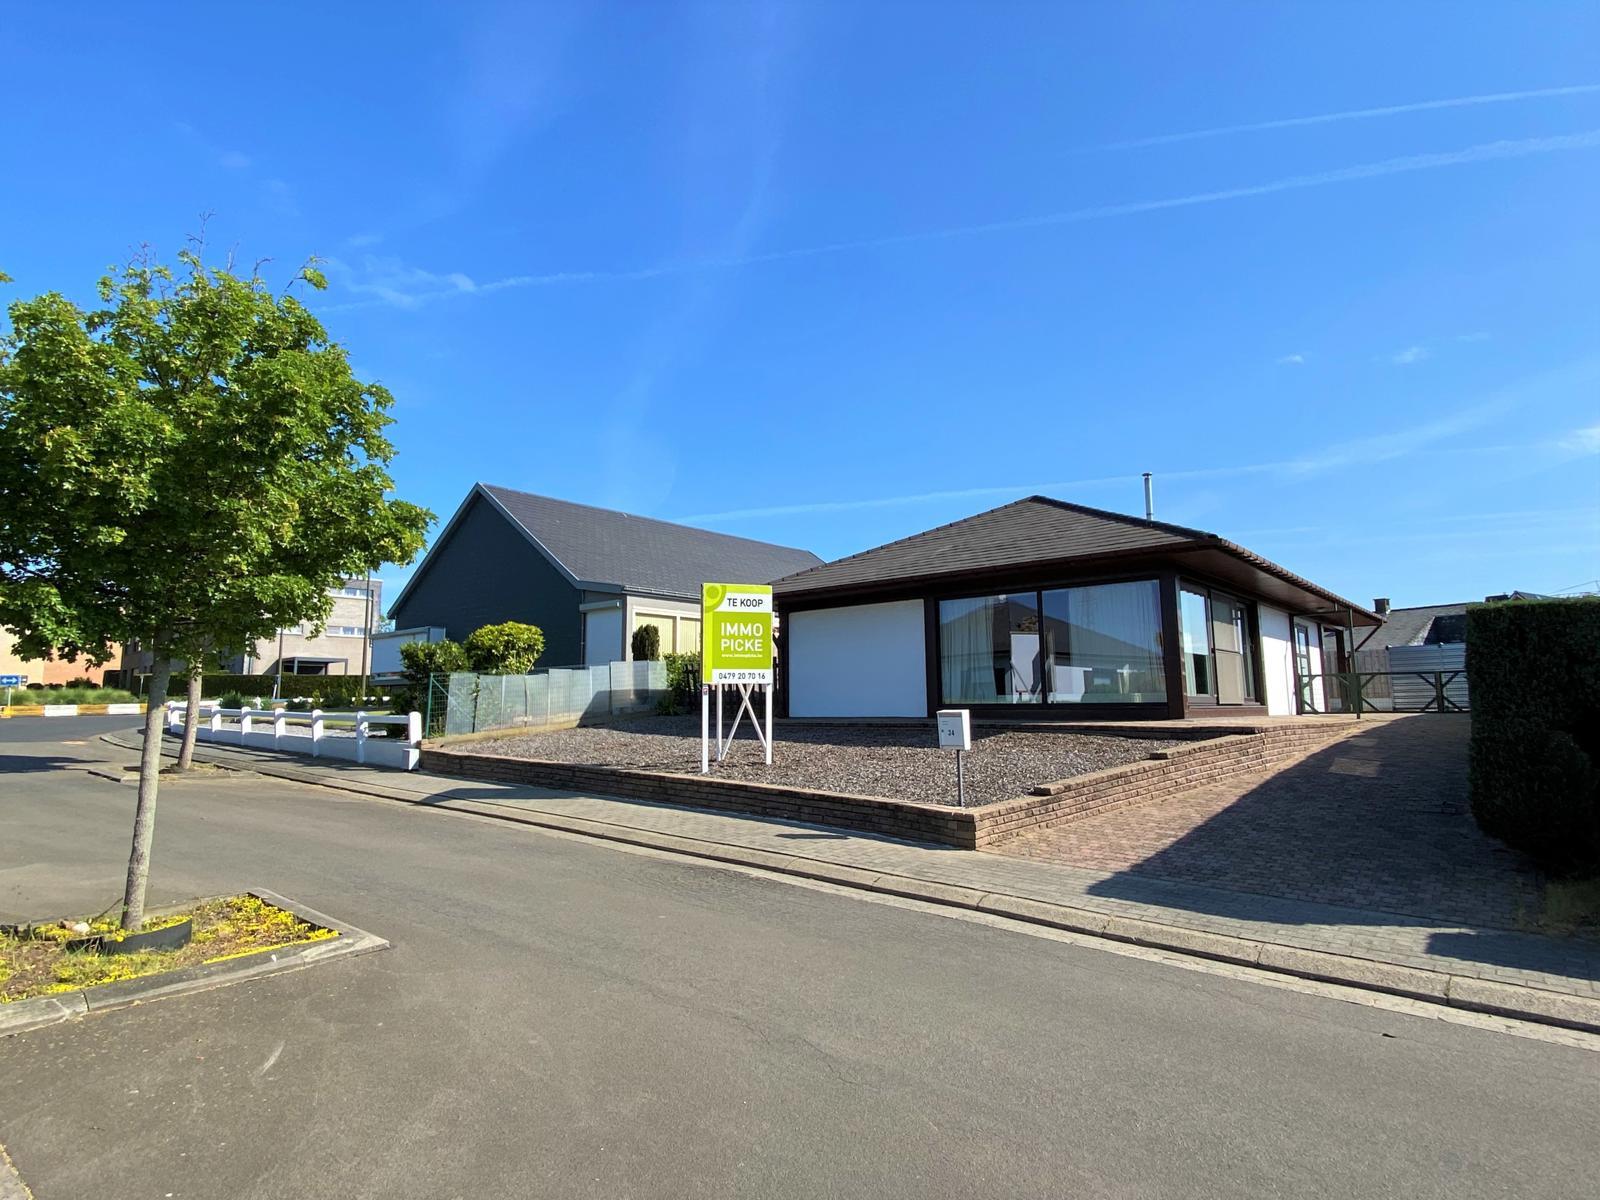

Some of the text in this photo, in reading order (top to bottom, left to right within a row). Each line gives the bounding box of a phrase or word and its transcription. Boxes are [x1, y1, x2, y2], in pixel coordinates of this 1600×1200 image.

[727, 598, 763, 608] TE KOOP
[721, 622, 763, 636] IMMO
[721, 639, 763, 651] PICKE
[718, 672, 766, 680] 0479 20 70 16
